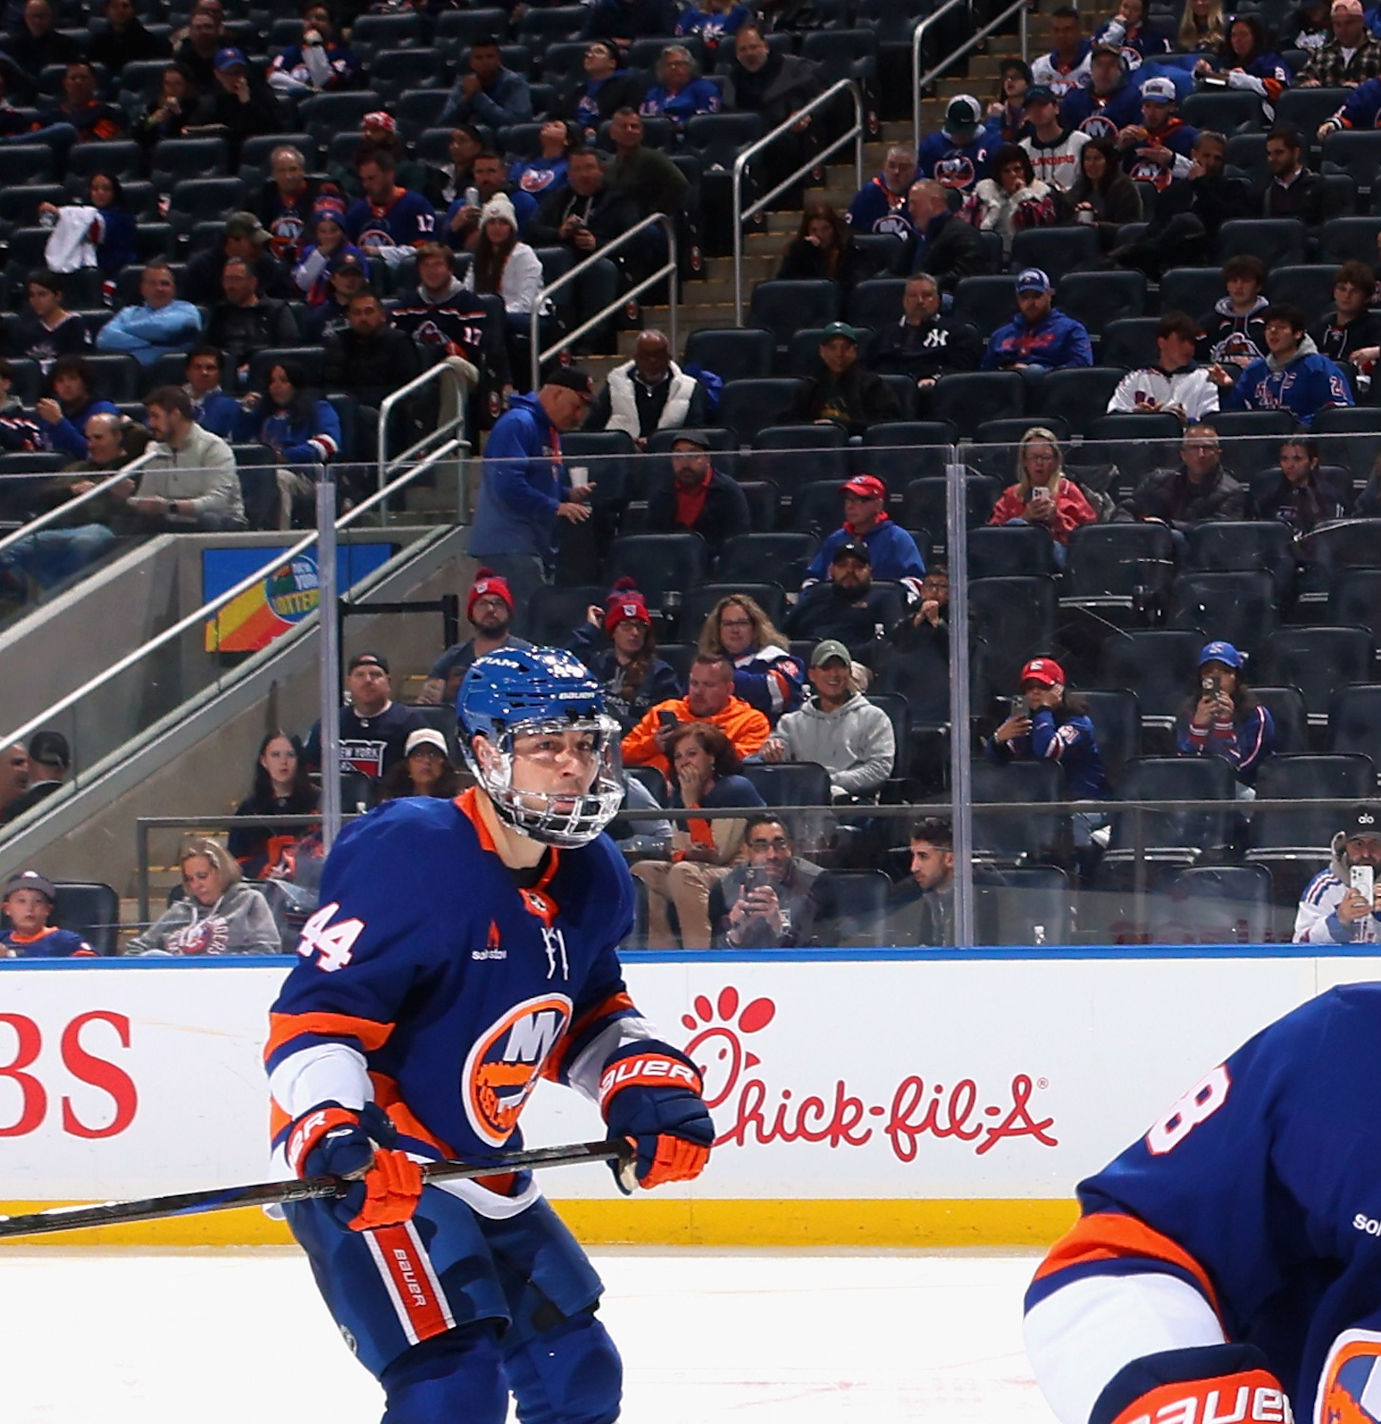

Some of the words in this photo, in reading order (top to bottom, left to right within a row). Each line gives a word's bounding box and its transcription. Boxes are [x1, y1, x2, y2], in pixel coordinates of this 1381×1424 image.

[1359, 812, 1375, 825] alo
[297, 901, 366, 972] 44
[0, 1009, 138, 1140] BS
[601, 1058, 697, 1096] AUER
[392, 1247, 427, 1307] BAUER
